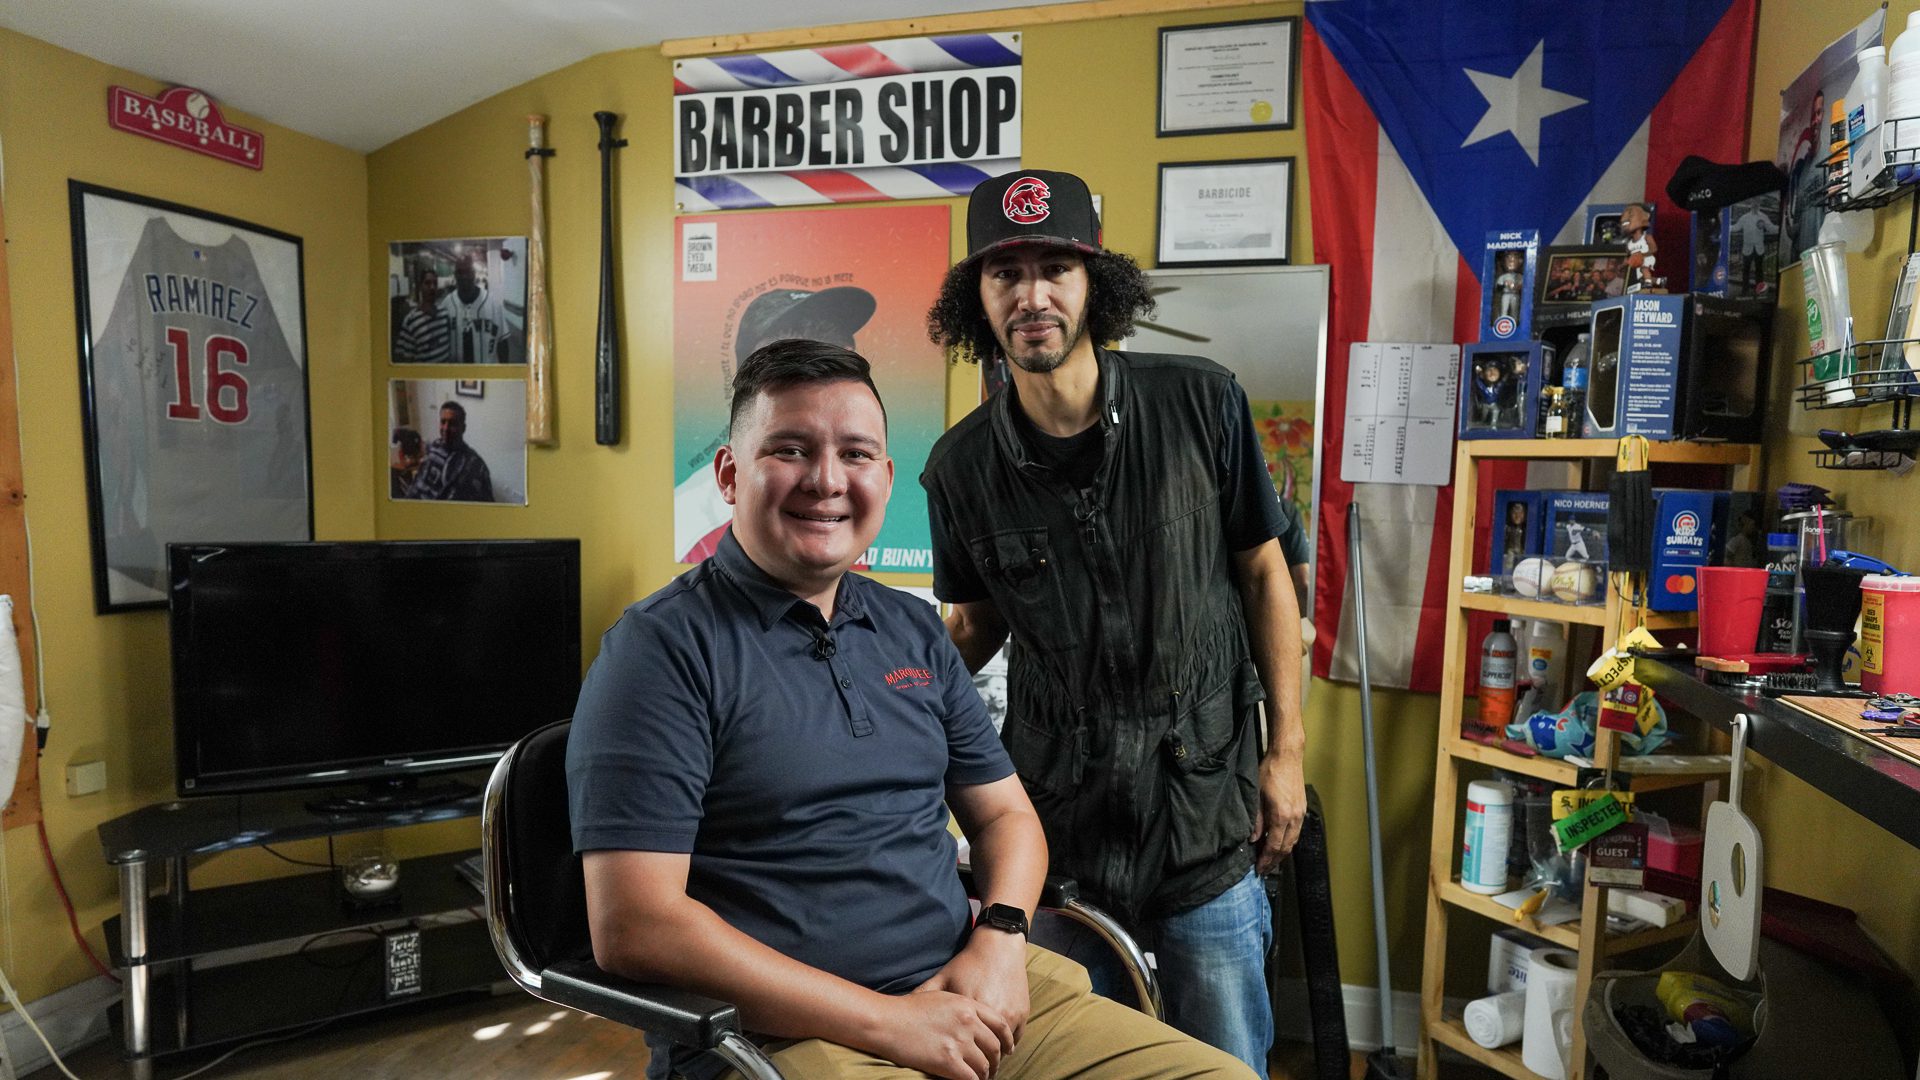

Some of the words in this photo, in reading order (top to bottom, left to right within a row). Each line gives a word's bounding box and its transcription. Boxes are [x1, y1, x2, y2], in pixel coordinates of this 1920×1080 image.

[123, 96, 255, 156] BASEBALL
[680, 87, 865, 174] BARBER
[878, 76, 1016, 163] SHOP
[1198, 187, 1251, 199] BARBICIDE
[1500, 232, 1523, 240] NICK
[688, 242, 712, 251] BROWN
[1487, 241, 1537, 249] MADRIGAL
[688, 263, 712, 272] MEDIA
[144, 273, 258, 329] RAMIREZ
[1634, 300, 1660, 311] JASON
[1633, 311, 1673, 323] HEYWARD
[165, 326, 249, 425] 16
[1554, 500, 1572, 508] NICO
[1675, 527, 1696, 536] KIDS
[1666, 536, 1703, 546] SUNDAYS
[854, 547, 878, 566] AD
[881, 548, 933, 568] BUNNY
[884, 668, 934, 685] MARQUEE
[1564, 801, 1623, 839] INSPECTED
[1596, 848, 1629, 857] GUEST
